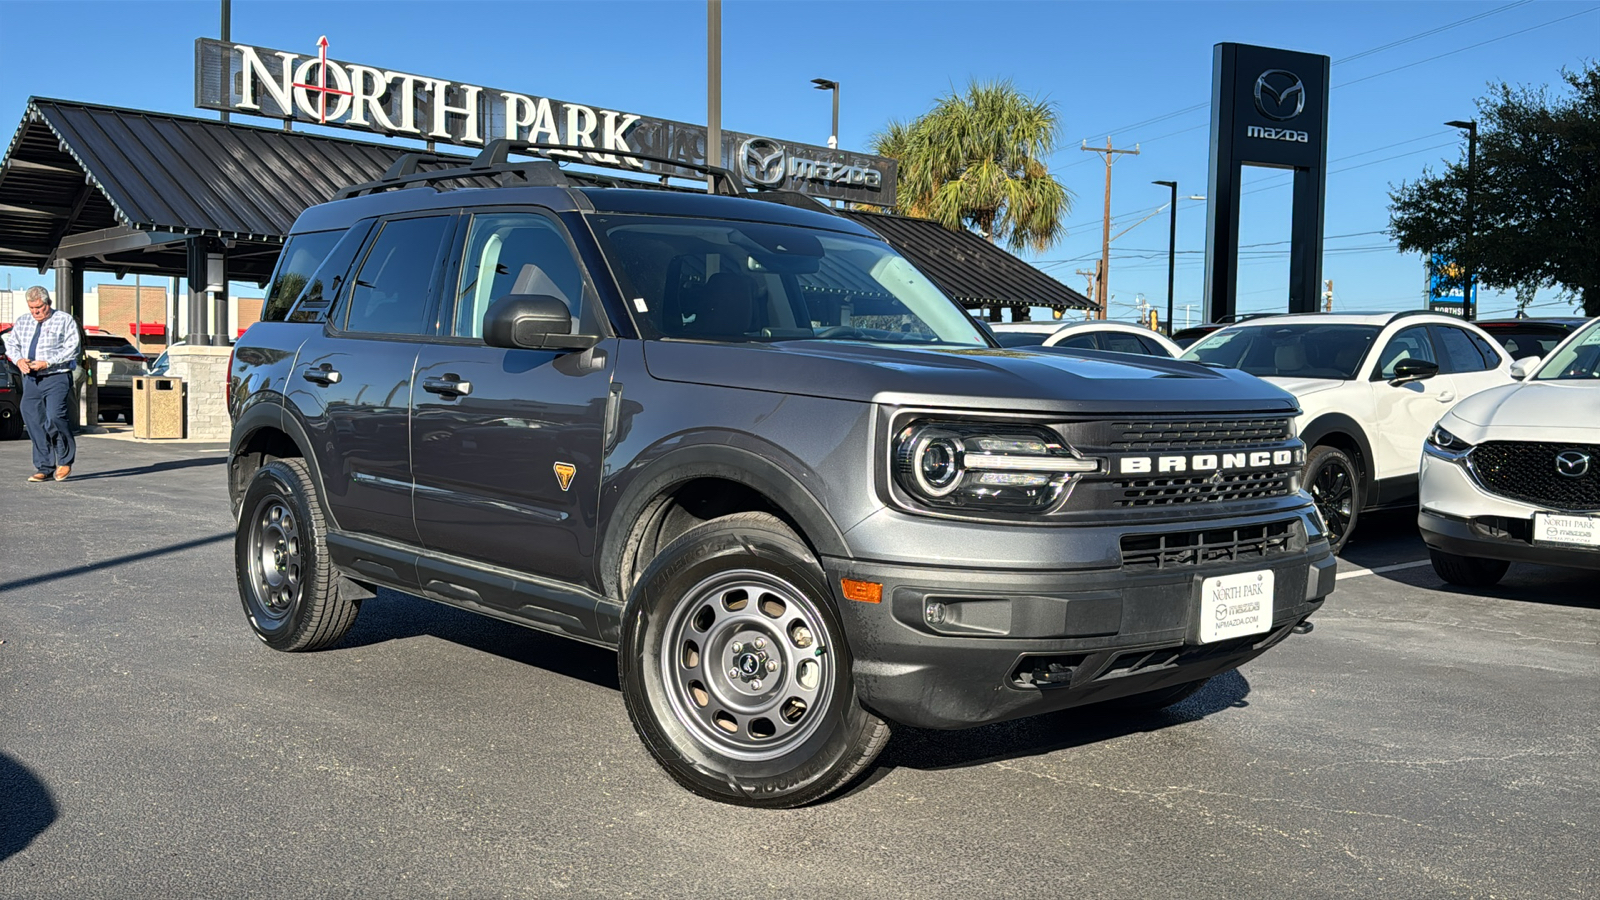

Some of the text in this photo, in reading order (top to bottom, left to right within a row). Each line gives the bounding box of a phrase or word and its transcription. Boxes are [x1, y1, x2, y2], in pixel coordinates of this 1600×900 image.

[234, 45, 483, 144] NORTH
[500, 92, 643, 167] PARK
[1247, 125, 1309, 143] mazda
[788, 156, 882, 189] mazda
[1120, 450, 1292, 474] BRONCO
[1544, 518, 1596, 530] NORTH PARK
[1212, 582, 1264, 602] NORTH PARK
[1228, 601, 1260, 616] mazda
[1215, 615, 1259, 630] NPMAZDA.COM
